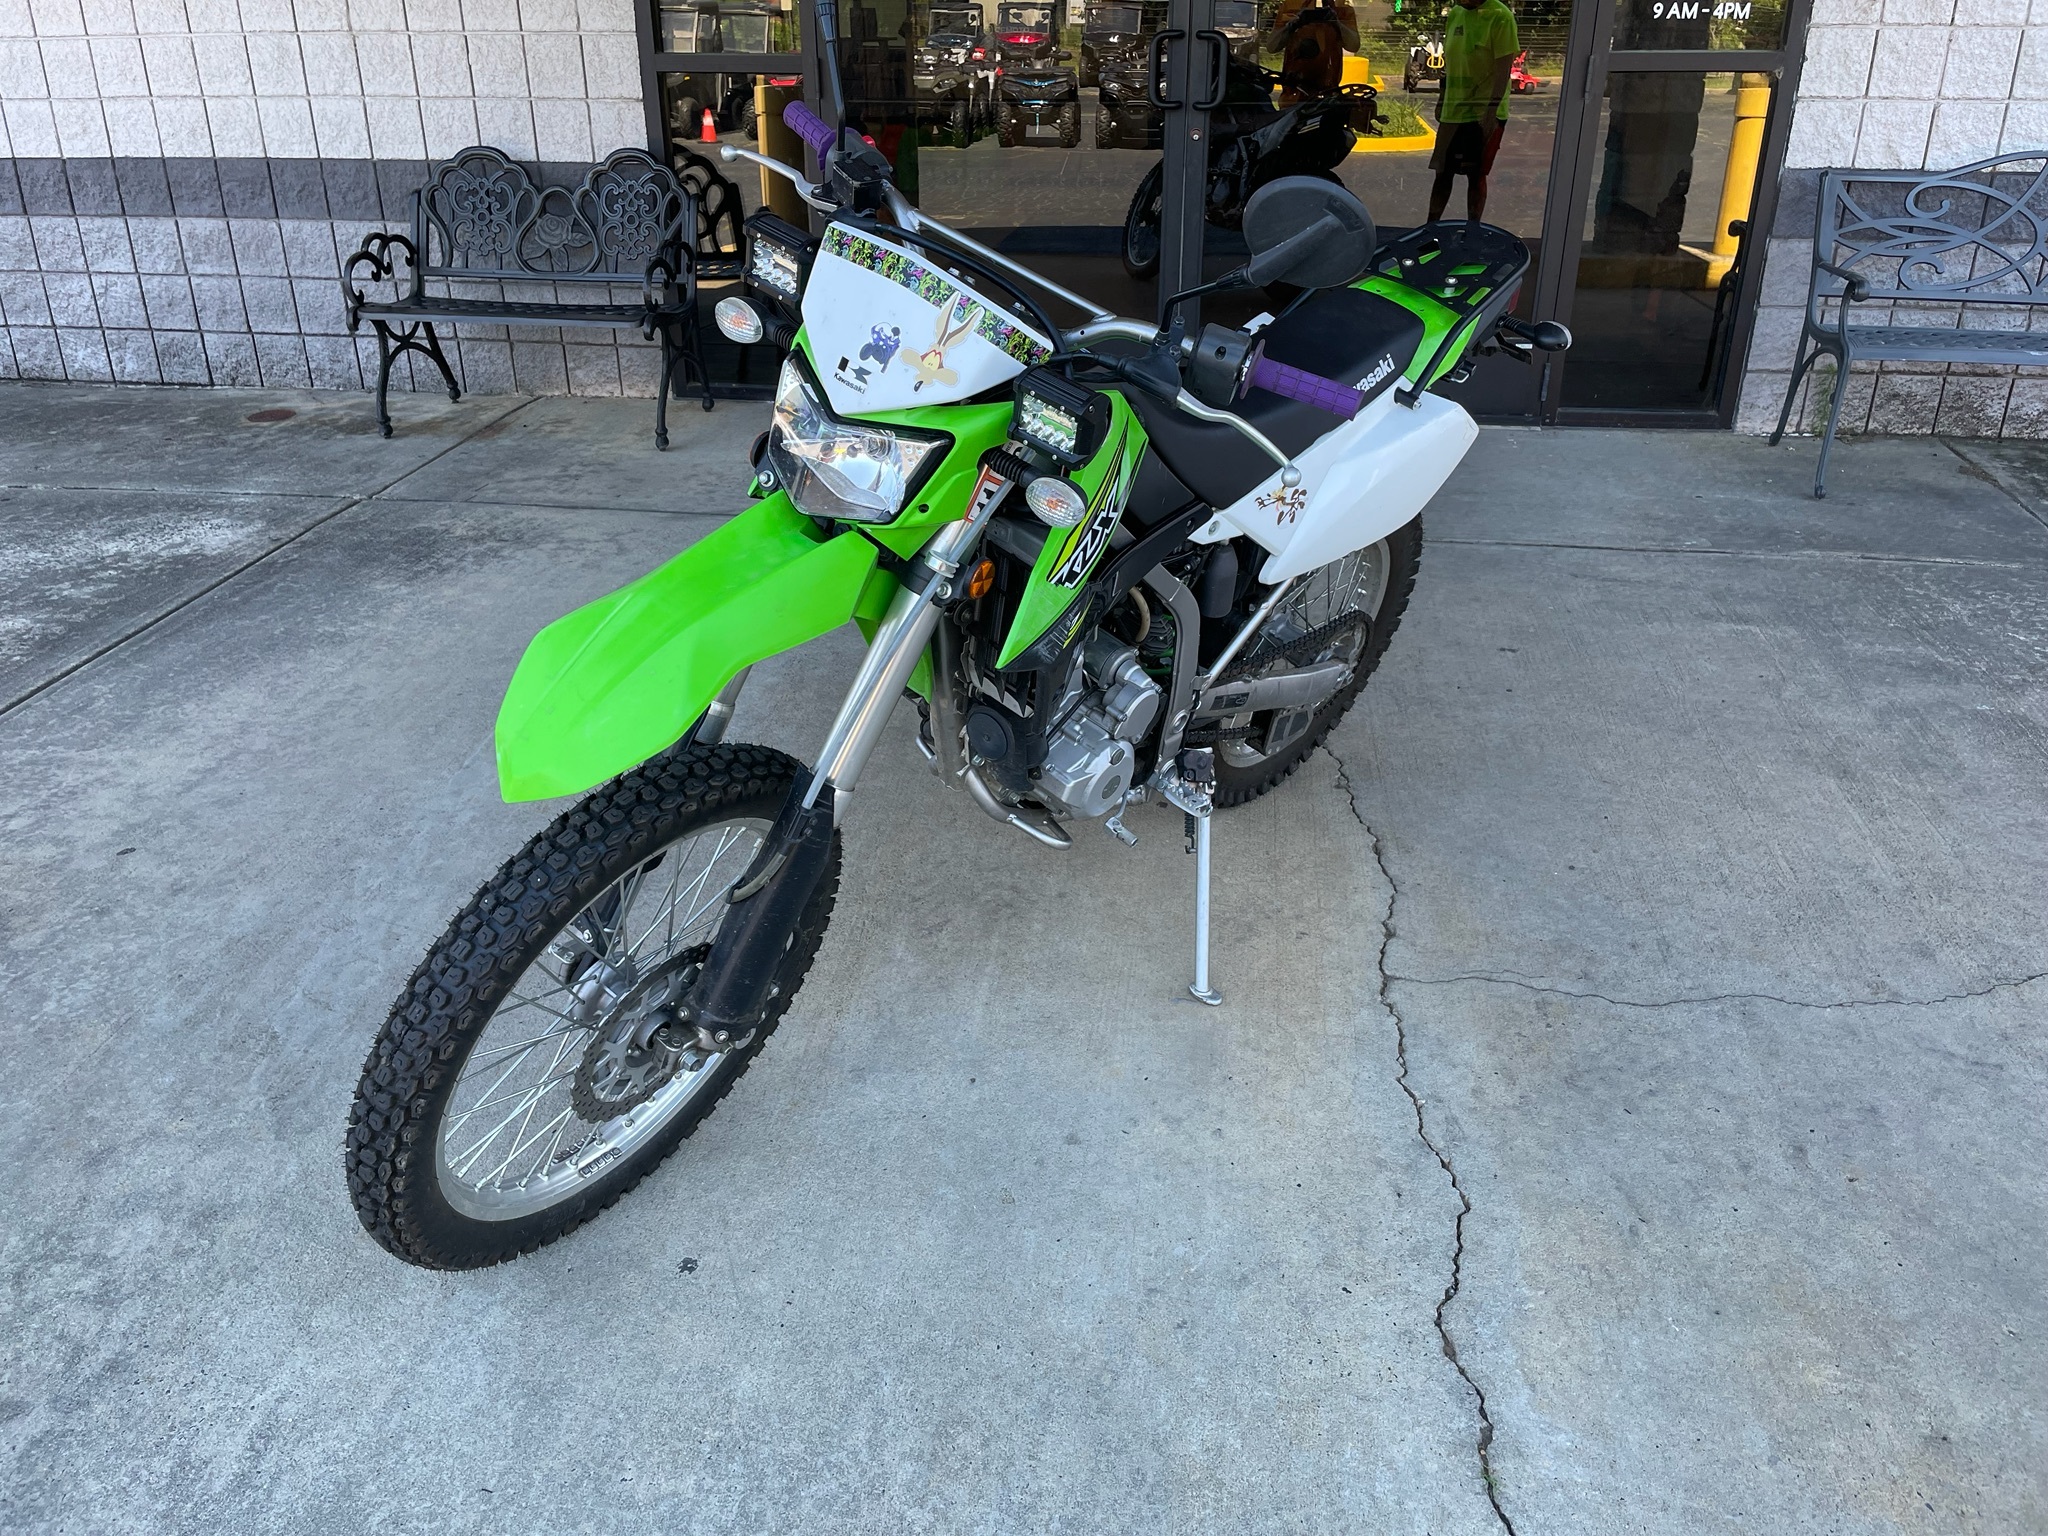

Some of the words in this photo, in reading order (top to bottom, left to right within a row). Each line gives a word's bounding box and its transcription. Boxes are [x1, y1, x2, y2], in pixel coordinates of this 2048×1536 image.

[1653, 2, 1664, 19] 9
[1666, 2, 1699, 19] AM
[1712, 2, 1752, 19] 4PM
[833, 372, 867, 395] Kawasaki
